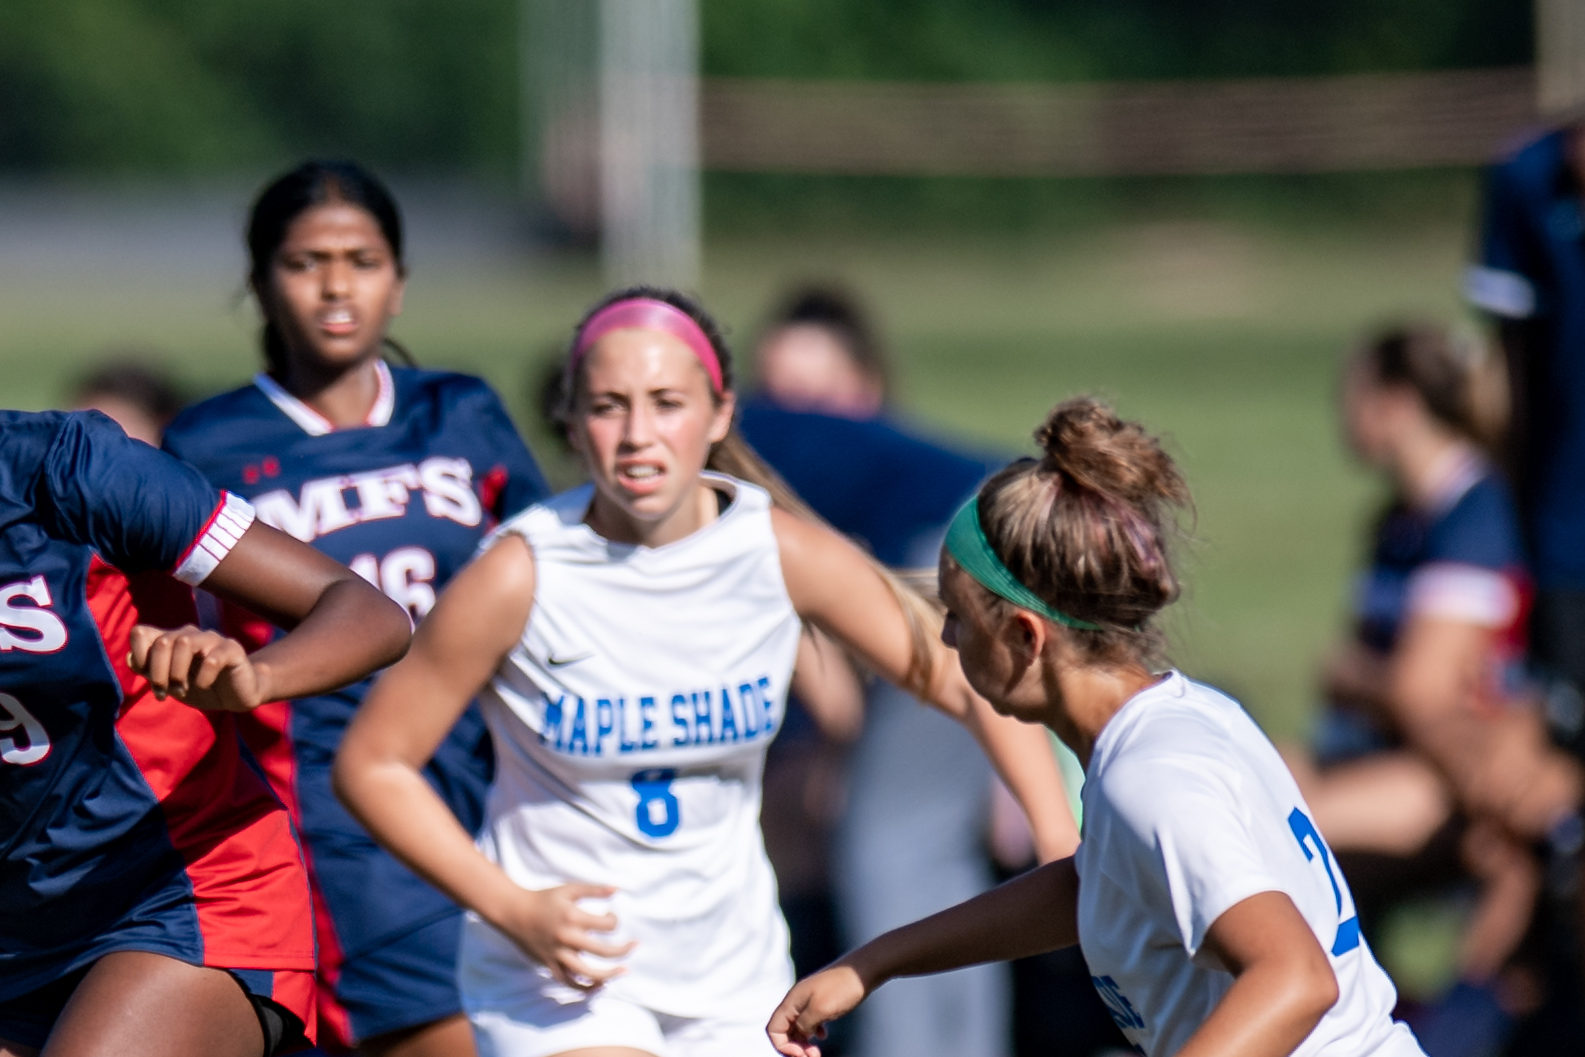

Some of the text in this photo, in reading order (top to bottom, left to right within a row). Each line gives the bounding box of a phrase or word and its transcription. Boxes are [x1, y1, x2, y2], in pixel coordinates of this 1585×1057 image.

[254, 456, 483, 543] MFS
[539, 676, 774, 755] MAPLE SHADE
[630, 768, 680, 838] 8
